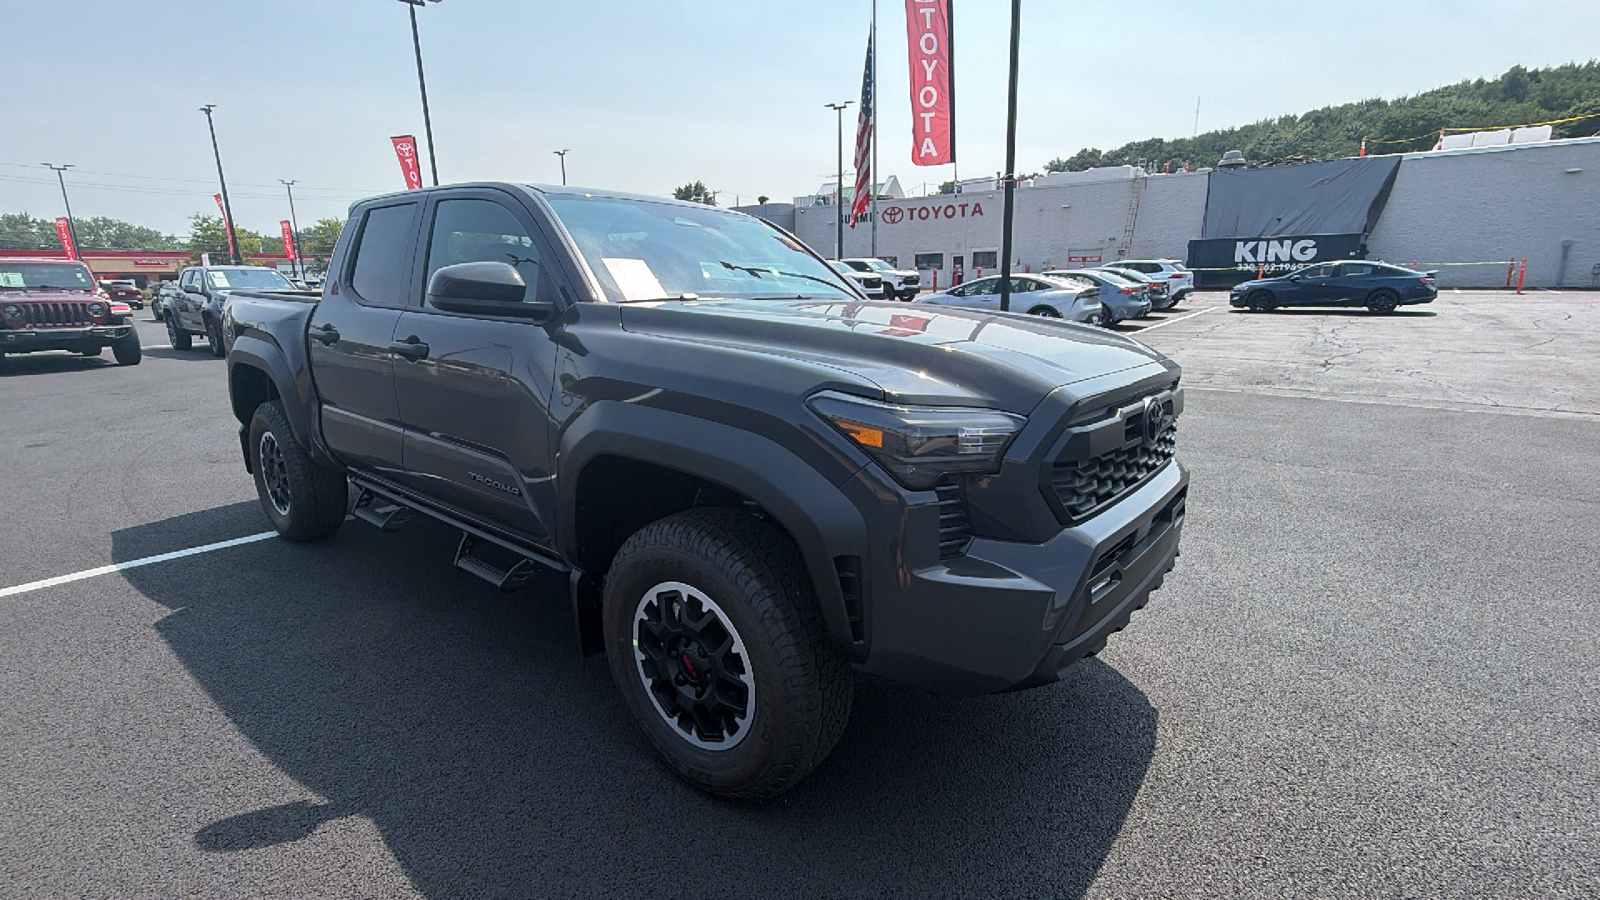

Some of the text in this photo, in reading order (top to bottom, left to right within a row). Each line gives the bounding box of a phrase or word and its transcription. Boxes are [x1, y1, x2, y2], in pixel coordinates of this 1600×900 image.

[919, 8, 938, 158] TOYOTA
[841, 203, 984, 224] UMI TOYOTA
[1234, 239, 1318, 262] KING
[467, 471, 520, 496] TACOMA
